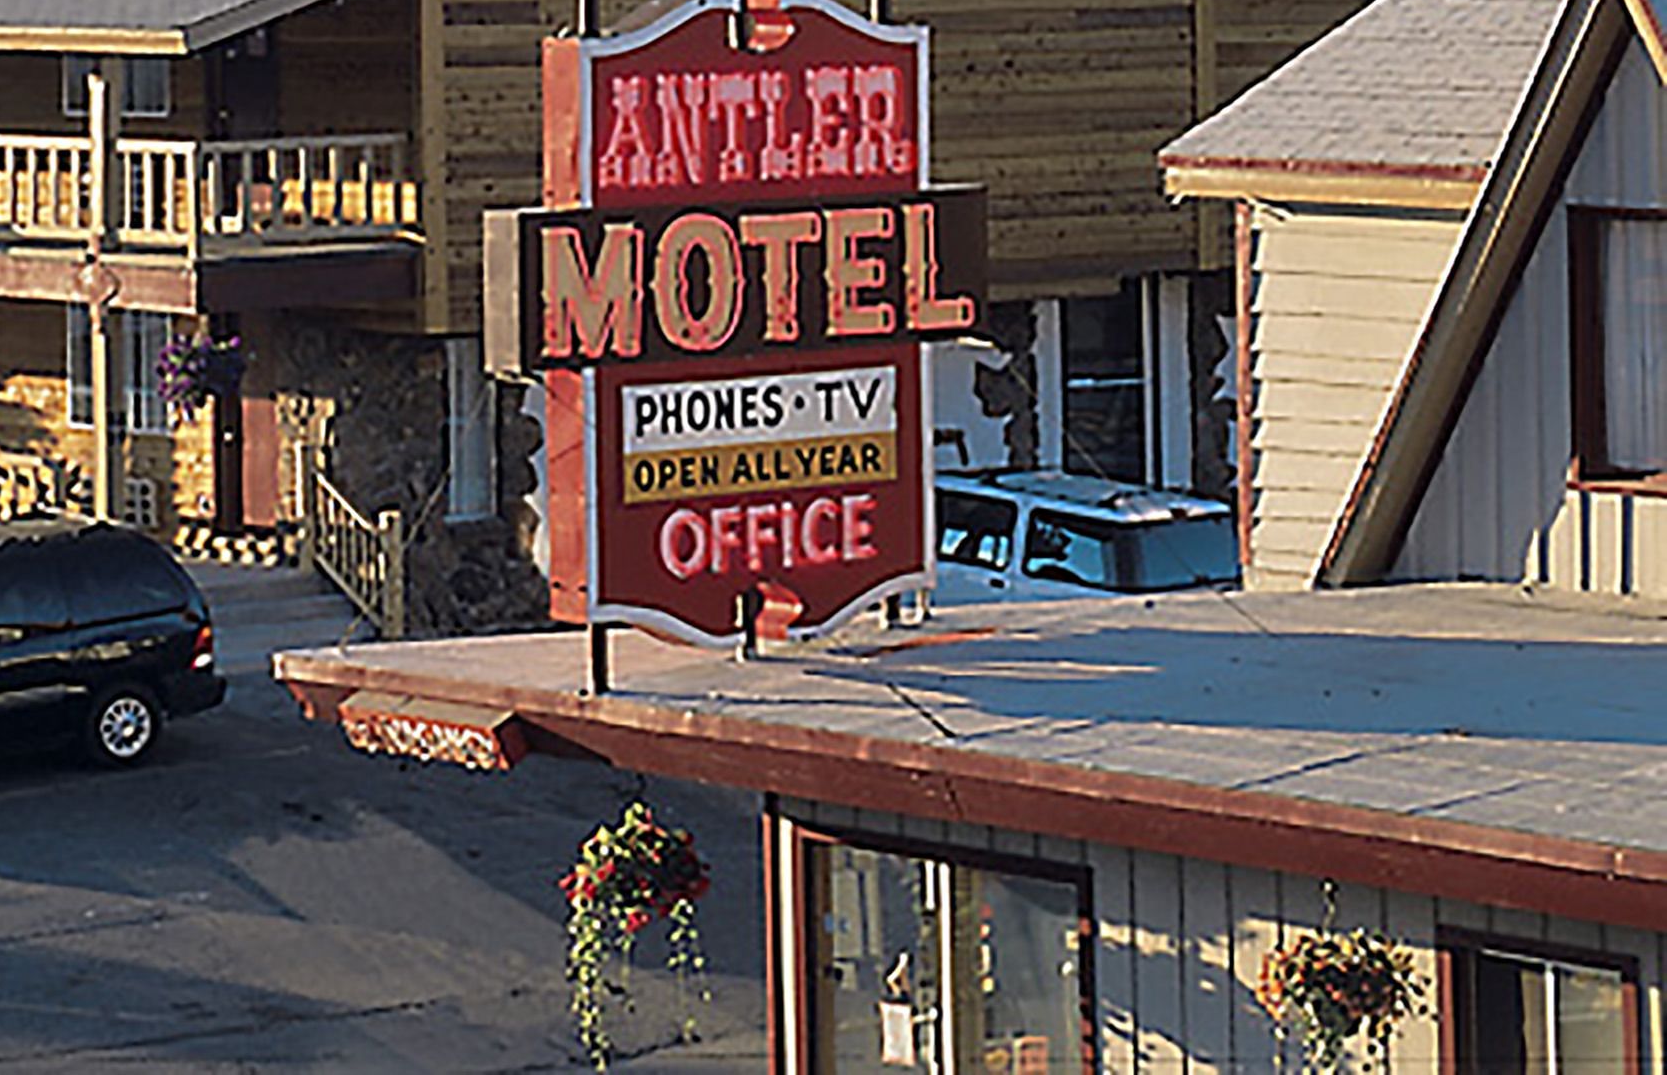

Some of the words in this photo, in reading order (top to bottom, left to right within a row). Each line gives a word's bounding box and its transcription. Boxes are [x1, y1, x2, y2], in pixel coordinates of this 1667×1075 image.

[599, 66, 918, 187] ANTLER
[541, 203, 975, 358] MOTEL
[635, 385, 784, 437] PHONES
[815, 378, 882, 422] TV
[634, 454, 720, 492] OPEN
[732, 452, 790, 484] ALL
[795, 443, 882, 477] YEAR
[659, 494, 878, 580] OFFICE
